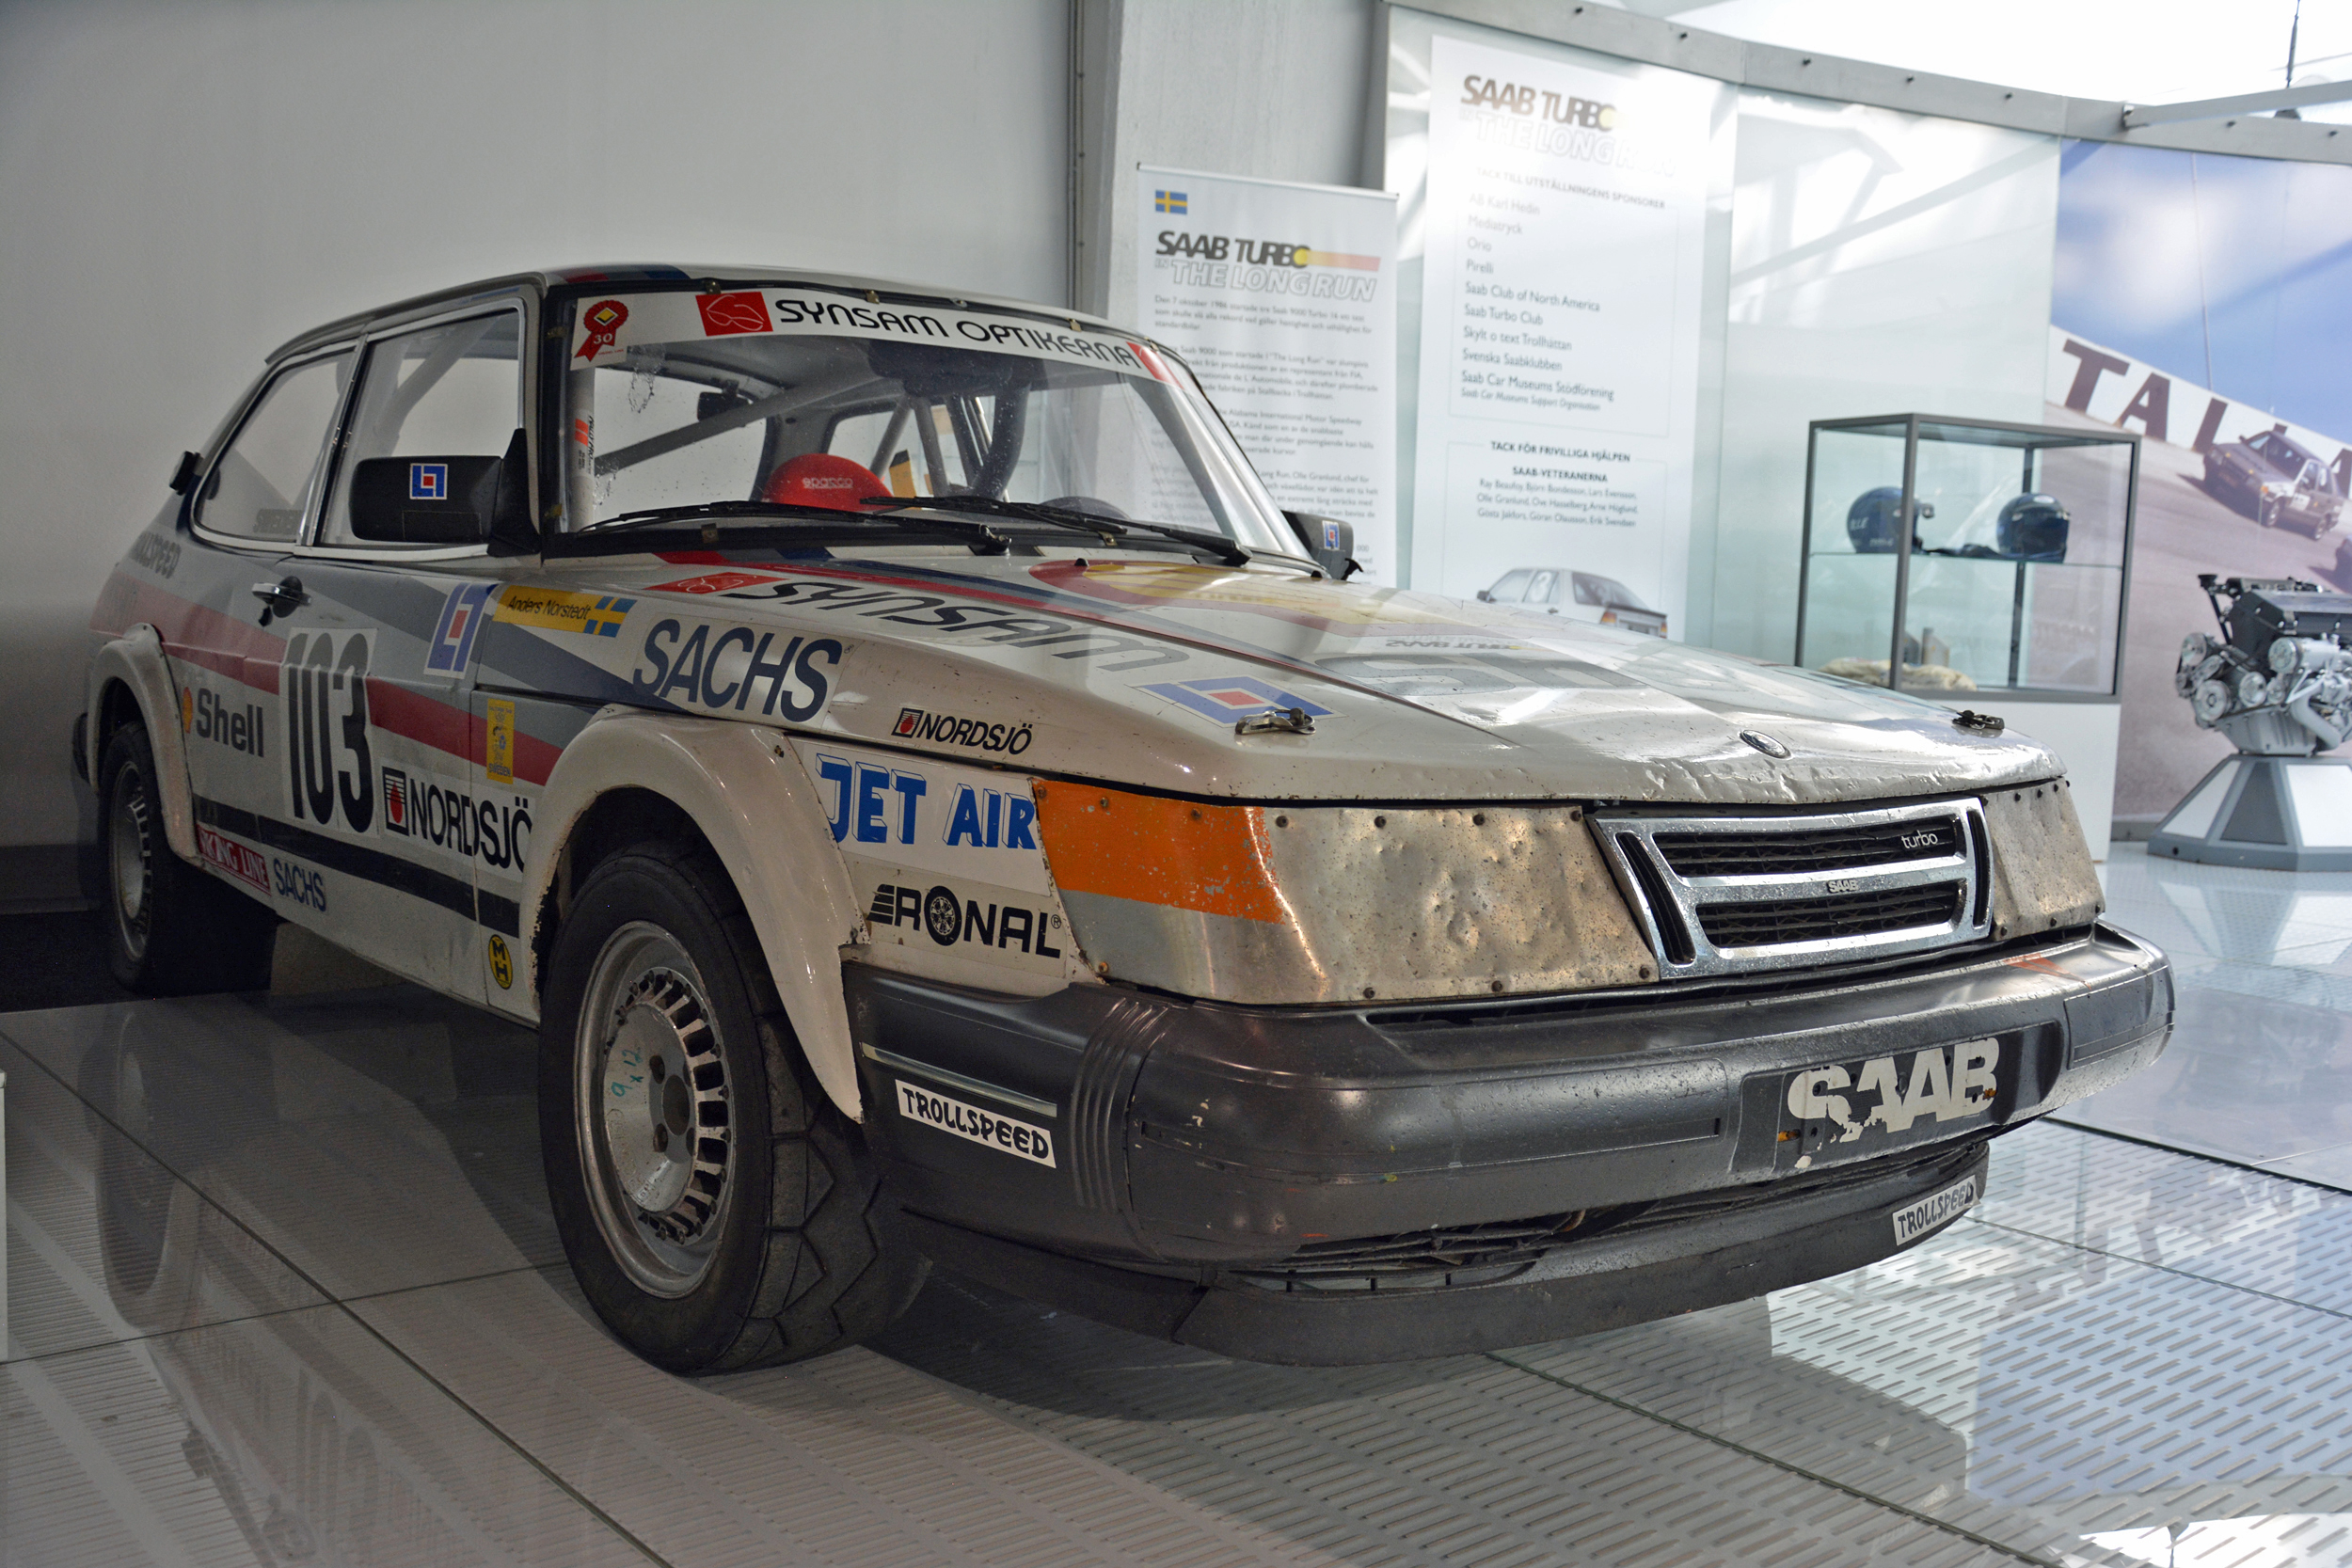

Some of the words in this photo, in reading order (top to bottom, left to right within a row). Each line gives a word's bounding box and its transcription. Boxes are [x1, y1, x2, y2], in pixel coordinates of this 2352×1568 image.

[1460, 74, 1536, 116] SAAB
[1541, 89, 1617, 133] TURBO
[1534, 123, 1614, 166] LONG
[1469, 192, 1485, 207] AB
[1487, 195, 1509, 211] Karl
[1510, 198, 1540, 216] Hedin
[1613, 191, 1665, 210] SPONSORER
[1468, 214, 1523, 235] Mediatryck
[1155, 230, 1231, 261] SAAB
[1234, 238, 1311, 269] TURBO
[1467, 236, 1492, 252] Orio
[1171, 259, 1228, 289] THE
[1231, 266, 1311, 296] LONG
[1312, 273, 1378, 303] RUN
[1466, 259, 1494, 275] Pirelli
[1465, 281, 1488, 297] Saab
[1490, 284, 1515, 300] Club
[1517, 289, 1528, 301] of
[1530, 291, 1560, 307] North
[1562, 295, 1601, 312] America
[1464, 304, 1486, 319] Saab
[1489, 307, 1518, 323] Turbo
[1519, 309, 1544, 325] Club
[594, 333, 613, 345] 30
[774, 299, 950, 339] SYNSAM
[956, 320, 1143, 371] OPTIKERNA
[1463, 325, 1487, 343] Skylt
[1500, 332, 1519, 345] text
[1462, 348, 1501, 365] Svenska
[1503, 353, 1563, 372] Saabklubben
[1461, 388, 1478, 398] Saab
[1481, 388, 1493, 400] Car
[1496, 391, 1529, 404] Museums
[1462, 371, 1484, 385] Saab
[1487, 373, 1504, 387] Car
[1508, 375, 1552, 392] Museums
[1490, 441, 1516, 451] TACK
[1518, 443, 1537, 453] FÖR
[1539, 446, 1589, 459] FRIVILLIGA
[1591, 448, 1630, 463] HJÄLPEN
[802, 477, 854, 490] sparco
[507, 594, 543, 614] Anders
[543, 600, 593, 621] Norstedt
[722, 580, 1192, 673] SYNSAM
[633, 618, 843, 723] SACHS
[197, 688, 264, 757] Shell
[283, 632, 374, 833] 103
[916, 713, 1033, 754] NORDSJÖ
[816, 753, 927, 845] JET
[942, 783, 1038, 850] AIR
[409, 777, 533, 874] NORDSJÖ
[1900, 830, 1938, 849] turbo
[239, 847, 269, 886] LINE
[273, 858, 326, 912] SACHS
[1827, 879, 1859, 894] SAAB
[1788, 1037, 2000, 1142] SAAB
[902, 1087, 1049, 1160] TROLLSPEED
[1898, 1180, 1975, 1238] TROLLSPEED
